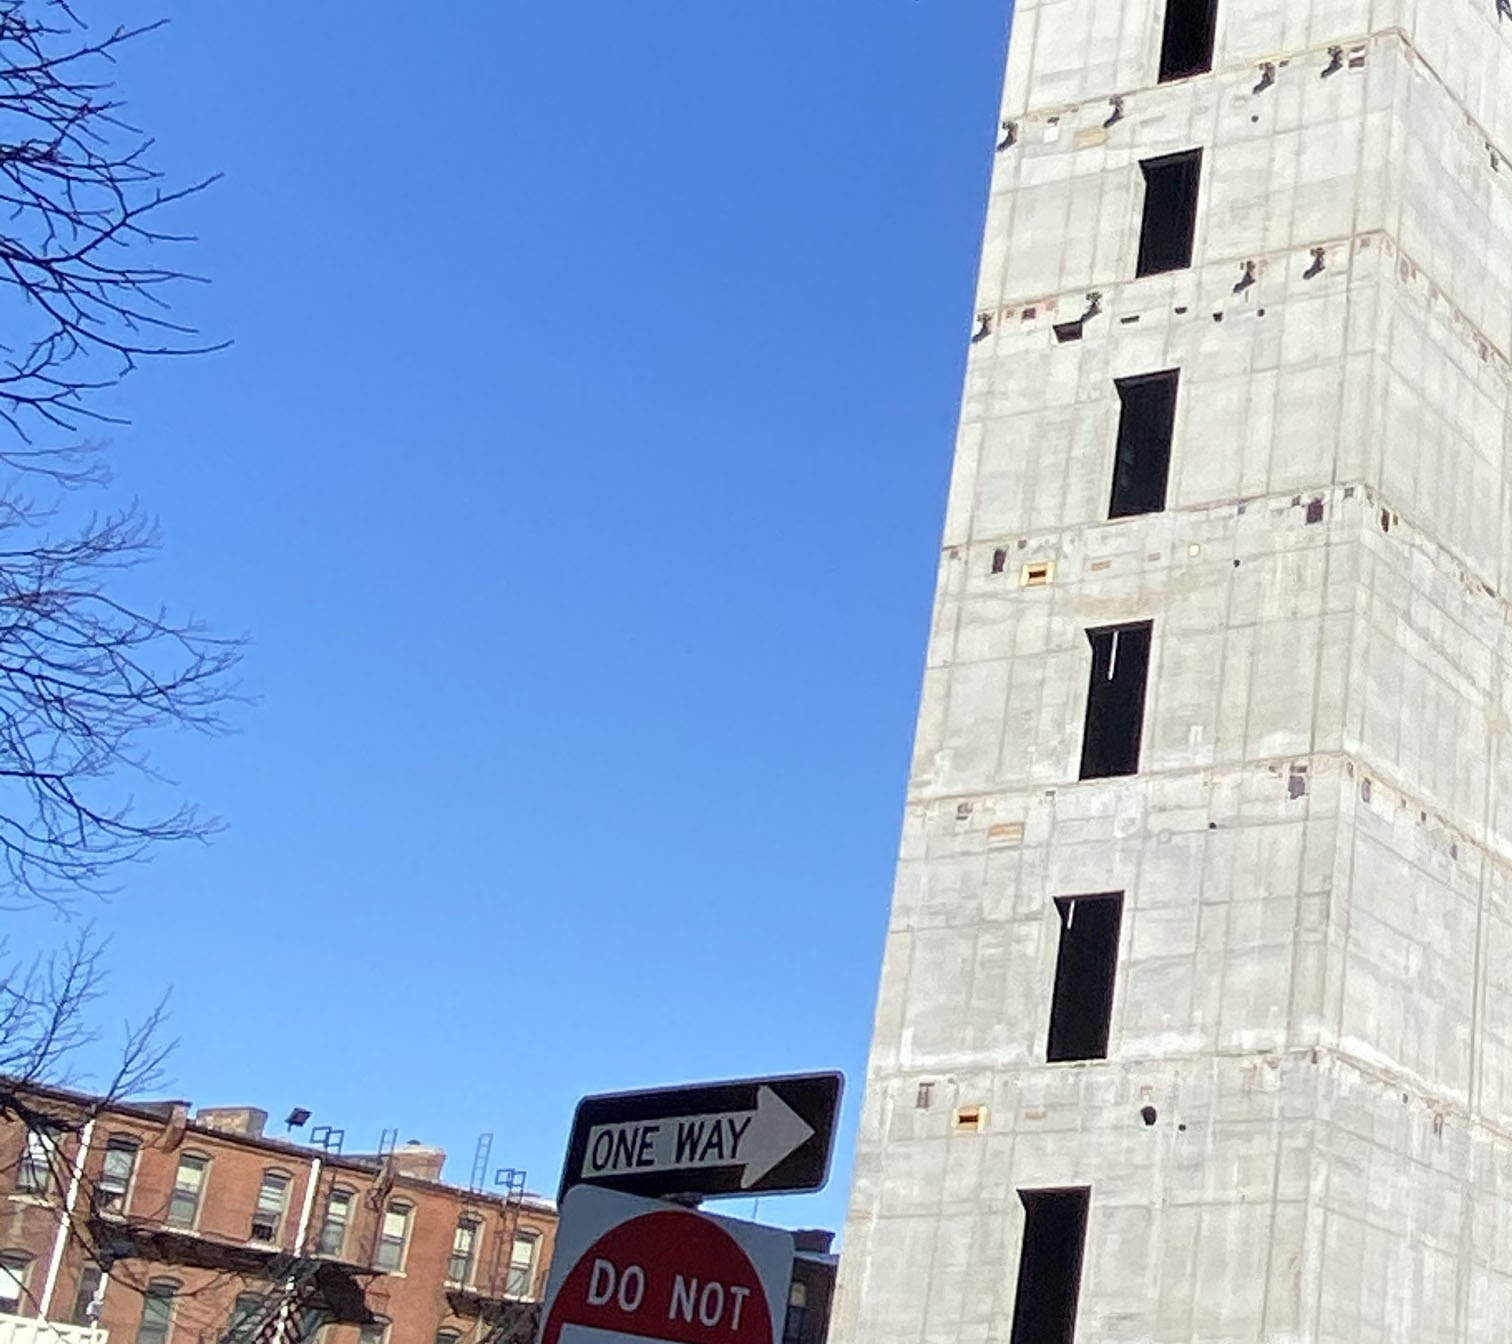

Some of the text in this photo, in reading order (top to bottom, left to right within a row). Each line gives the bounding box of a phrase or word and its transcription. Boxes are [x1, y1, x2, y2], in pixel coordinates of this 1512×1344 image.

[591, 1116, 752, 1173] ONE WAY
[586, 1258, 752, 1332] DO NOT
